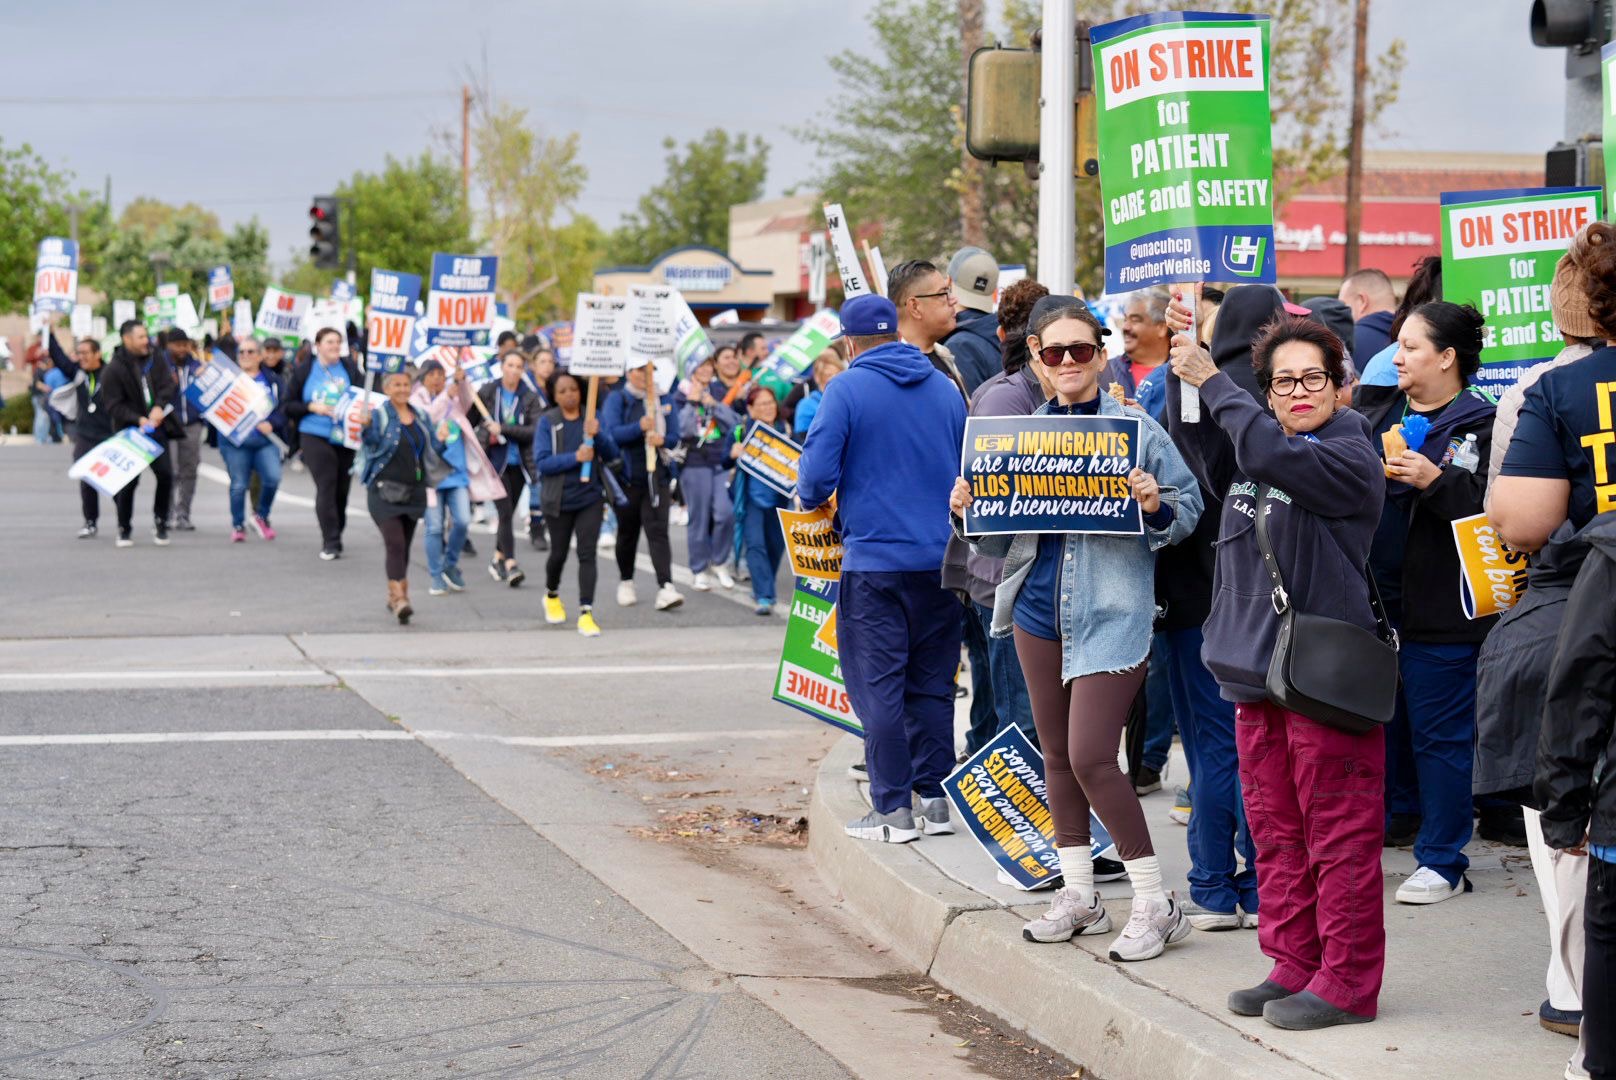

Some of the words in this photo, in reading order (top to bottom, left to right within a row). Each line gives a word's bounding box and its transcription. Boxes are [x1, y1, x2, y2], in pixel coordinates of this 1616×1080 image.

[1110, 48, 1141, 94] ON
[1148, 39, 1253, 82] STRIKE
[1157, 100, 1190, 127] for
[1130, 133, 1230, 179] PATIENT
[1110, 189, 1146, 225] CARE
[1150, 181, 1191, 213] and
[1197, 179, 1268, 207] SAFETY
[1459, 215, 1494, 248] ON
[1502, 206, 1588, 244] STRIKE
[1130, 237, 1192, 260] @unacuhcp
[1119, 257, 1211, 284] #TogetherWeRise
[1510, 257, 1536, 280] for
[438, 295, 489, 326] NOW
[1481, 284, 1552, 317] PATIEN
[371, 317, 407, 348] OW
[581, 339, 621, 348] STRIKE
[633, 325, 670, 335] STRIKE
[1501, 322, 1537, 346] and
[975, 437, 1015, 452] USW
[1017, 431, 1129, 457] IMMIGRANTS
[971, 454, 1003, 473] are
[1008, 449, 1084, 474] welcome
[1087, 450, 1131, 474] here
[1014, 474, 1129, 499] INMIGRANTES
[972, 498, 1008, 518] son
[1009, 491, 1131, 519] bienvenidos!
[1473, 525, 1499, 566] son
[786, 670, 850, 714] STRIKE
[971, 765, 1000, 798] here
[957, 773, 1030, 862] IMMIGRANTS
[994, 798, 1047, 853] welcome
